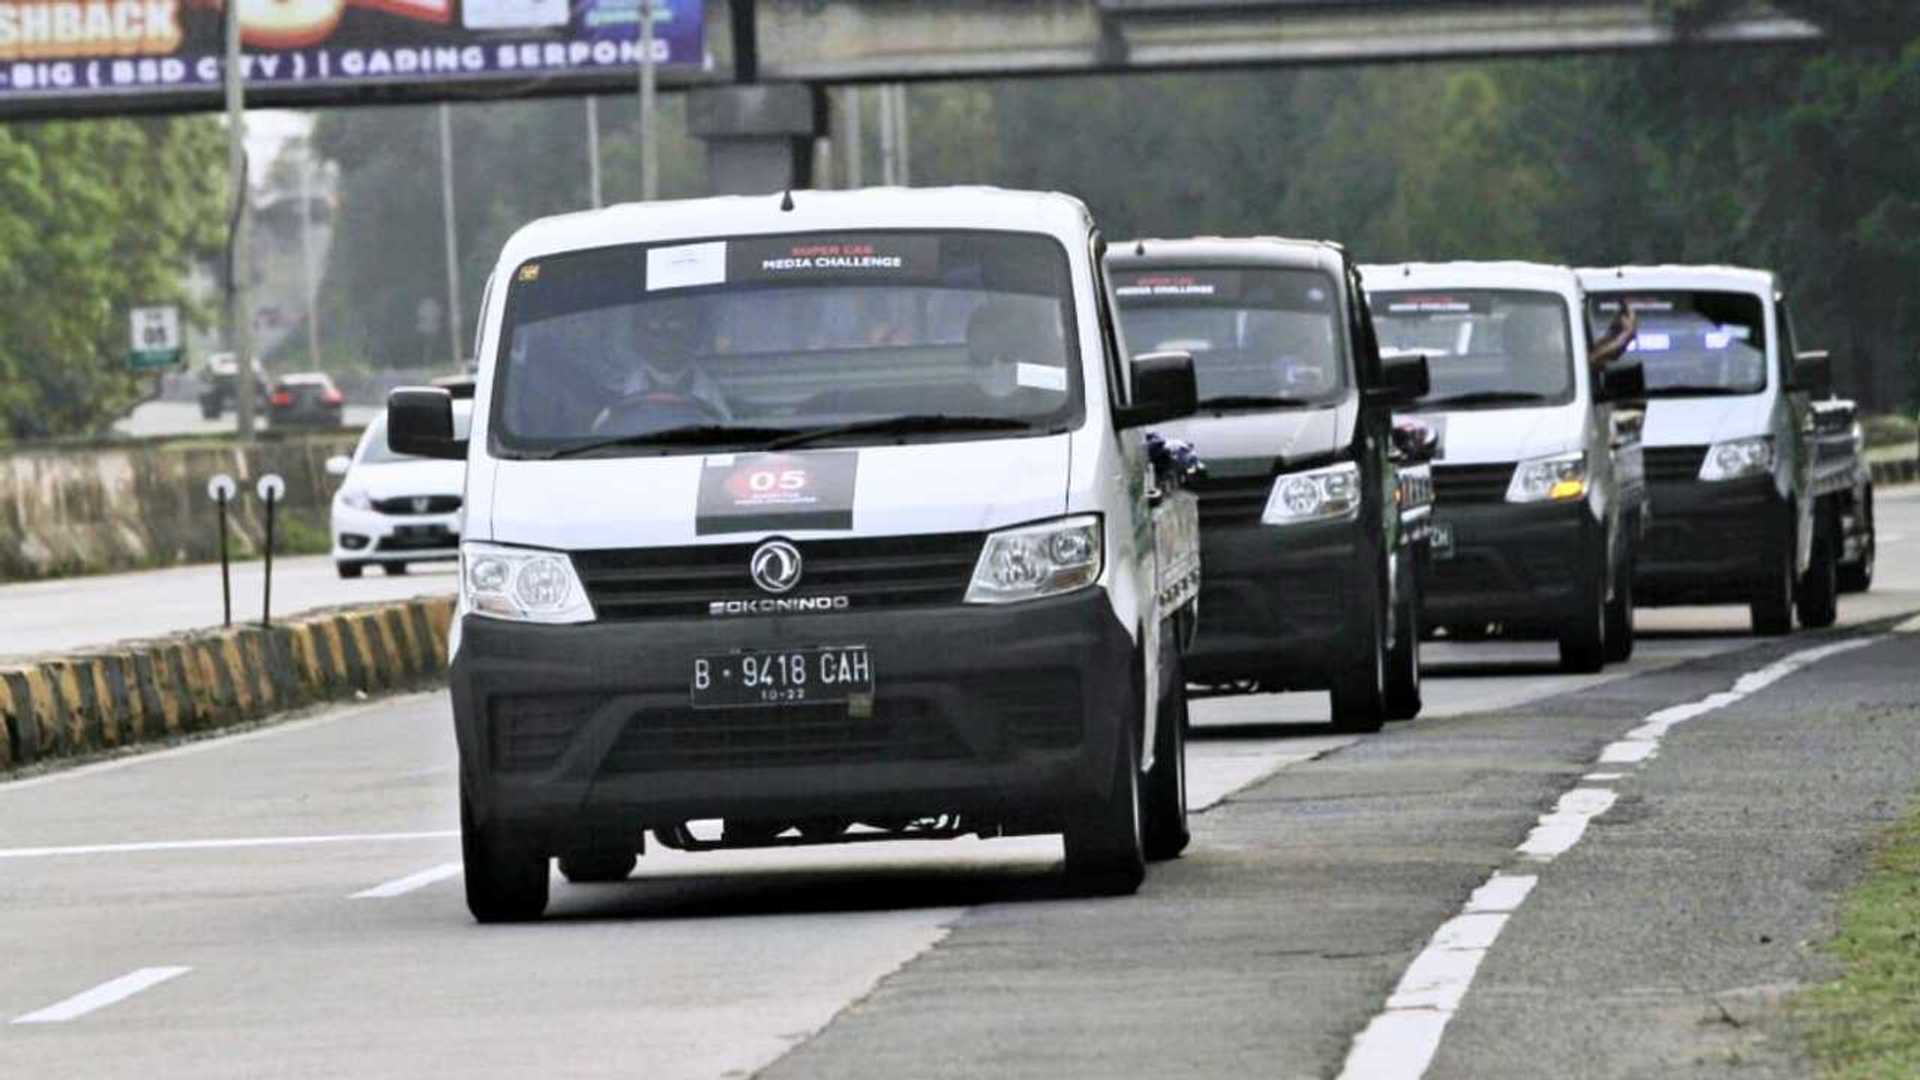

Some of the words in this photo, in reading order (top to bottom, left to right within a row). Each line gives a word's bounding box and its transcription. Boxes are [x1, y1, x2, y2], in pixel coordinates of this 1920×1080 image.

[112, 58, 186, 85] BSD
[196, 53, 280, 81] CTY
[340, 45, 484, 76] GADING
[497, 38, 670, 69] SERPONG
[762, 258, 812, 270] MEDIA
[815, 256, 902, 269] CHALLENGE
[750, 469, 806, 492] 05
[708, 595, 849, 615] SOKONINDO
[694, 658, 711, 691] B
[742, 653, 807, 688] 9418
[820, 650, 870, 685] CAH
